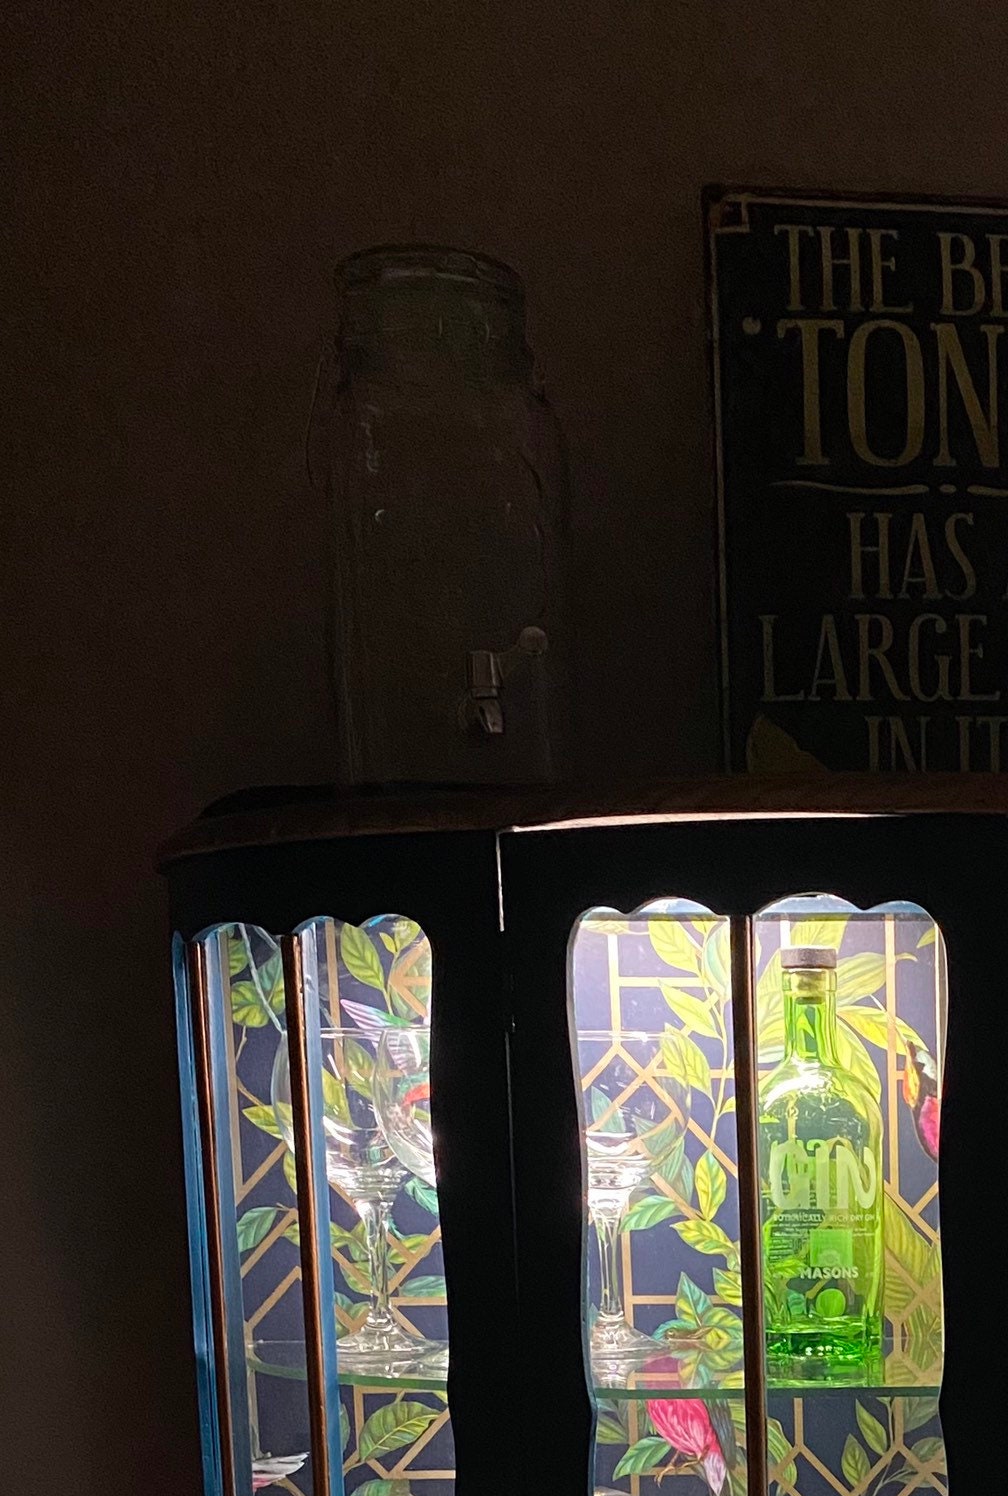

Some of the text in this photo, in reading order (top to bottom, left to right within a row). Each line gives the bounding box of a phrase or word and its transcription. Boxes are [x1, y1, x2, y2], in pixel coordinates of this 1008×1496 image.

[773, 225, 914, 313] THE
[846, 511, 978, 602] HAS
[758, 614, 1001, 703] LARGE
[864, 715, 930, 772] IN
[769, 1140, 876, 1209] GIN
[799, 1265, 860, 1280] MASONS
